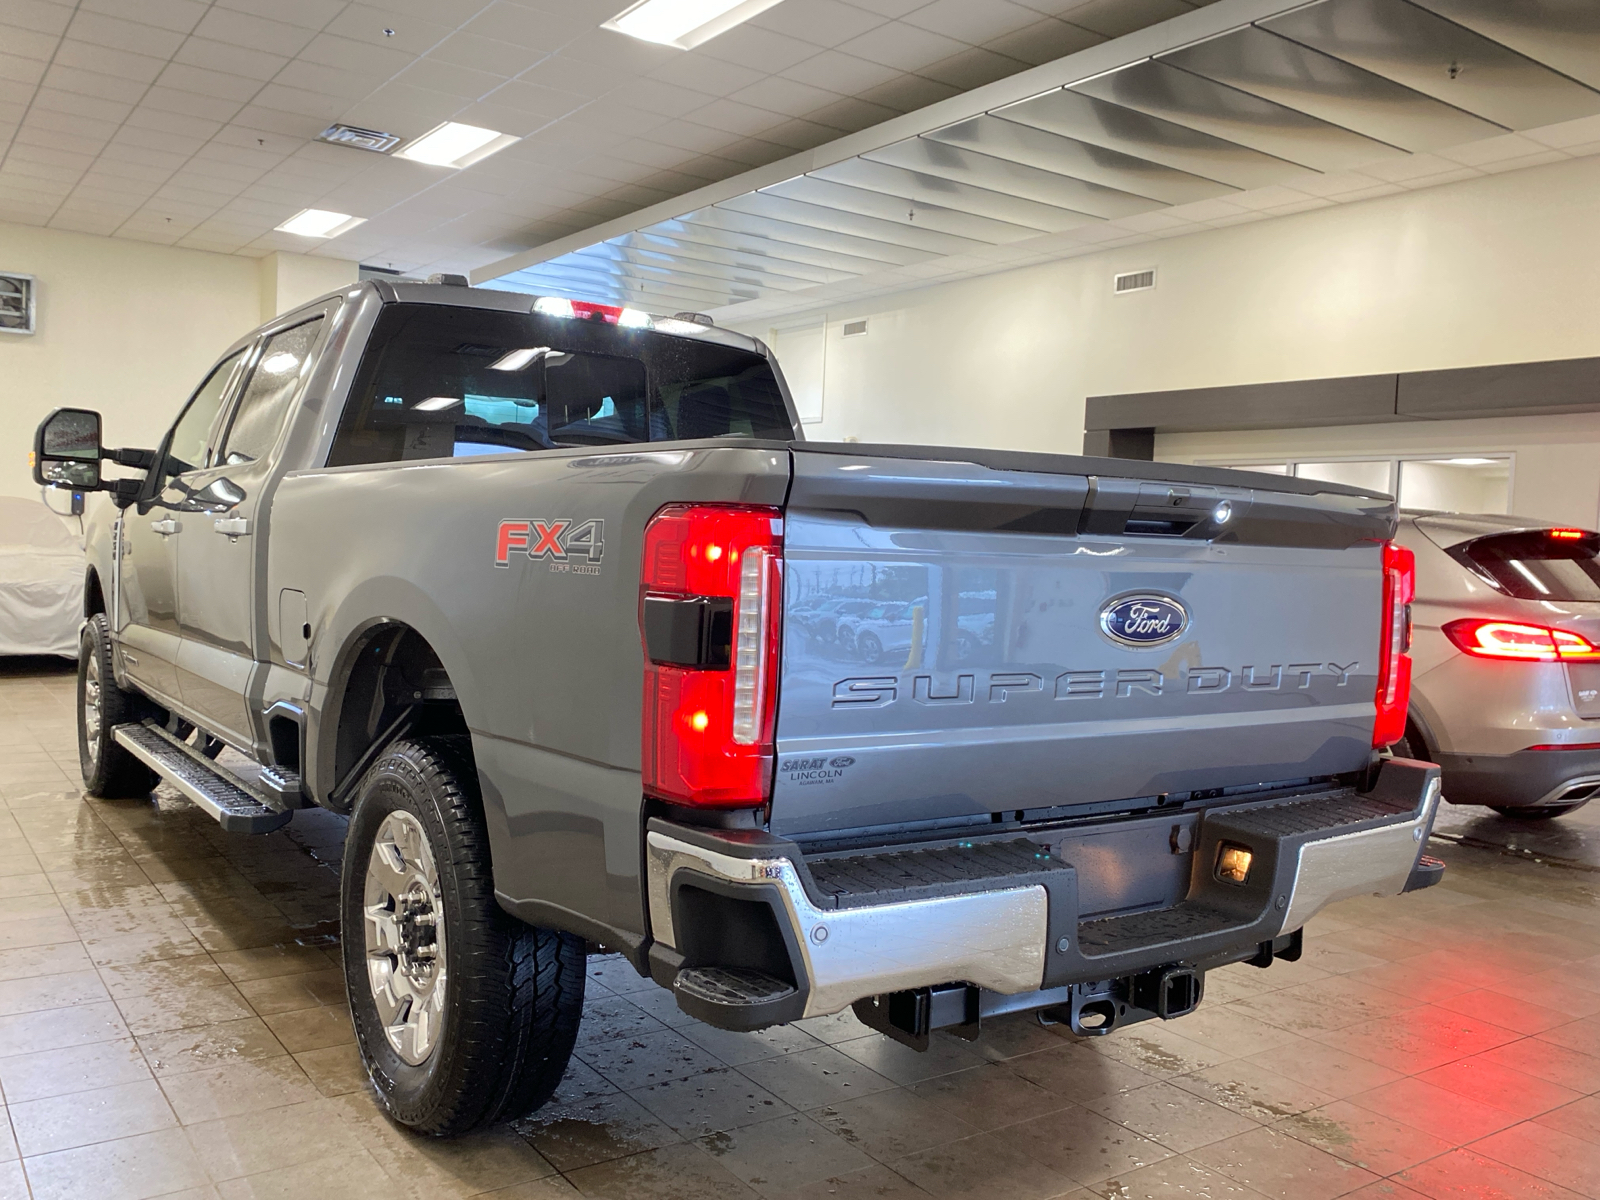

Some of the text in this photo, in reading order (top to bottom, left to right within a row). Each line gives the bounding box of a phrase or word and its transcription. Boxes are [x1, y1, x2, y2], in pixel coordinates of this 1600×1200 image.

[494, 518, 604, 568] FX4
[549, 563, 601, 576] OFF ROAD
[1124, 602, 1172, 634] Ford
[831, 661, 1359, 710] SUPER DUTY
[780, 757, 828, 772] SARAT
[790, 769, 843, 780] LINCOLN
